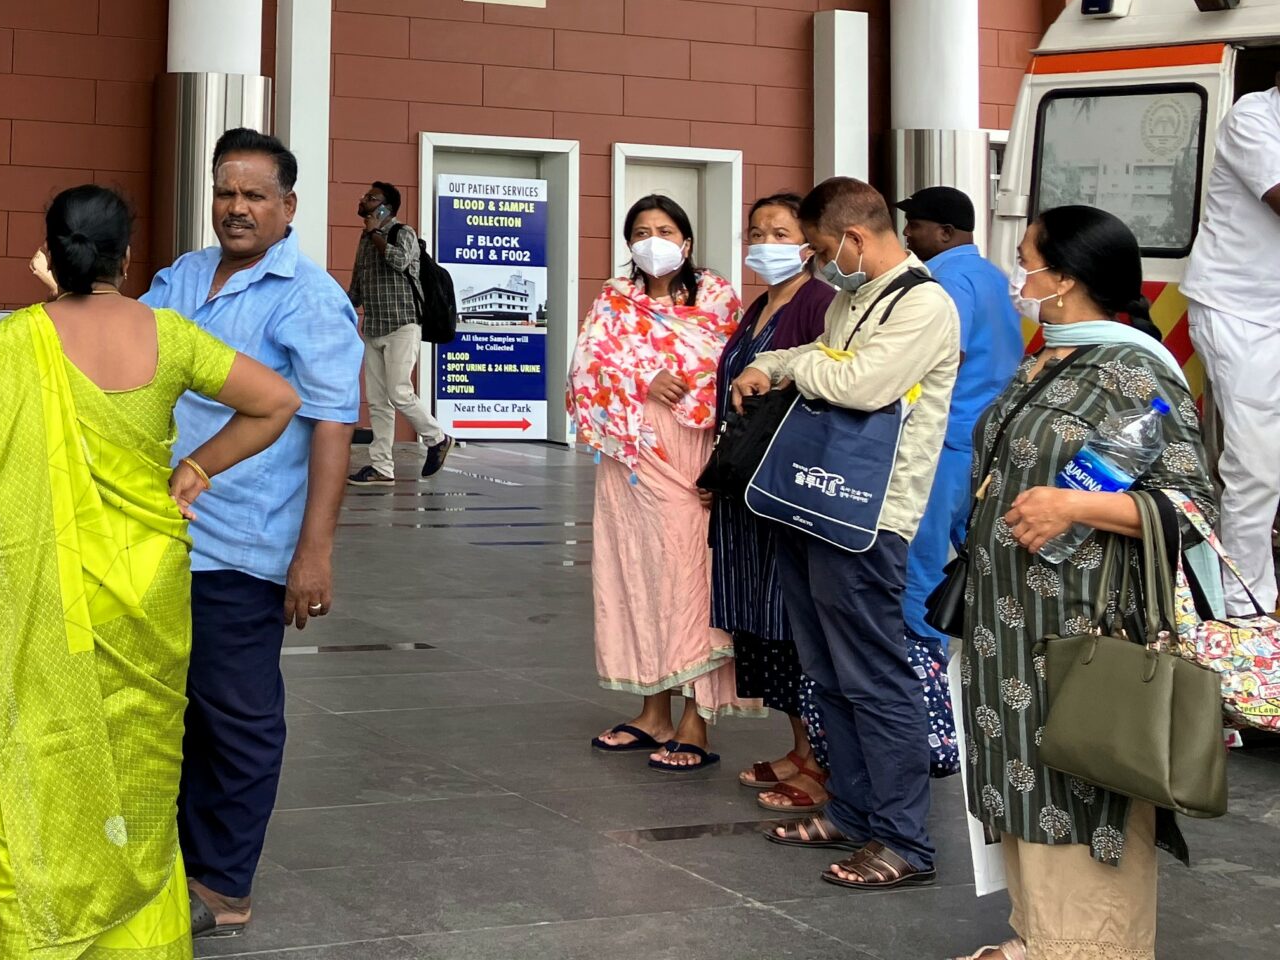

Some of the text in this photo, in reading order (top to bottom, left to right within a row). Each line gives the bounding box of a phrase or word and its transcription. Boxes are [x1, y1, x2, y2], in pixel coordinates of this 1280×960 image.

[449, 182, 539, 197] OUT PATIENT SERVICES
[453, 199, 535, 213] BLOOD & SAMPLE
[466, 215, 522, 228] COLLECTION
[466, 235, 520, 248] F BLOCK
[455, 247, 531, 262] F001 & F002
[461, 334, 471, 342] All
[472, 334, 488, 342] these
[489, 335, 515, 344] Samples
[447, 352, 470, 361] BLOOD
[447, 363, 464, 372] SPOT
[466, 364, 486, 372] URINE
[494, 364, 503, 372] 24
[504, 364, 519, 373] HRS.
[520, 365, 541, 373] URINE
[447, 374, 469, 383] STOOL
[447, 385, 475, 394] SPUTUM
[454, 403, 532, 413] Near the Car Park
